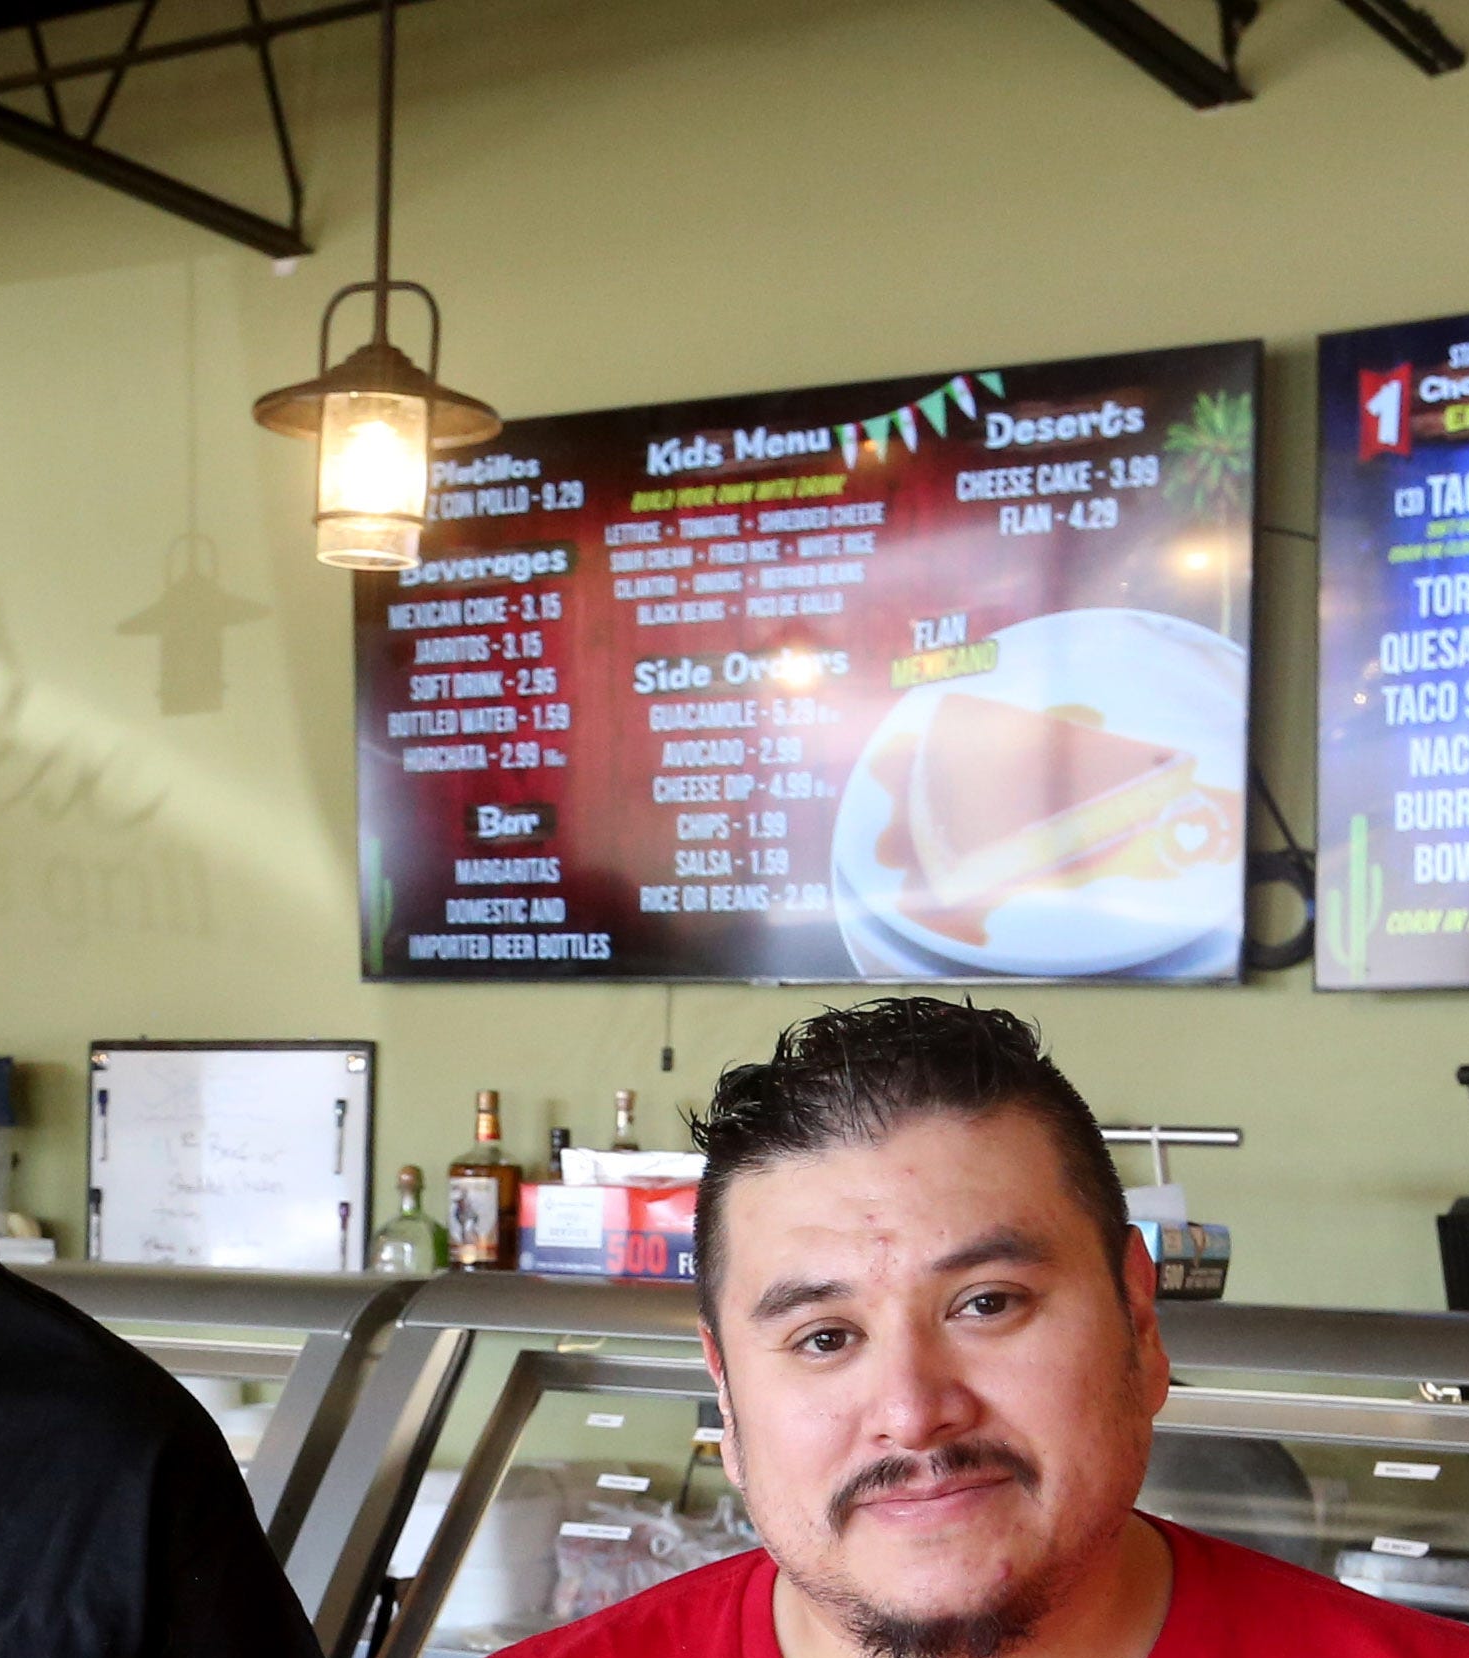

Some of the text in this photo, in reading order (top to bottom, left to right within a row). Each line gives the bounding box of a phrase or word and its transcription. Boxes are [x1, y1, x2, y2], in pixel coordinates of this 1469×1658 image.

[983, 400, 1145, 450] Deserts
[1365, 379, 1403, 446] 1
[645, 426, 831, 477] Kids Menu
[955, 454, 1160, 502] CHEESE CAKE 3.99
[999, 497, 1119, 536] FLAN 4.29
[398, 549, 568, 588] Beverages
[388, 600, 463, 630] MEXICAN
[463, 596, 509, 625] COKE
[912, 613, 967, 651] FLAN
[409, 673, 451, 702] SOFT
[633, 657, 713, 695] Side
[1381, 680, 1459, 727] TACO
[652, 774, 722, 804] CHEESE
[476, 804, 540, 839] Bar
[676, 811, 730, 840] CHIPS
[455, 856, 561, 885] MARGARITAS
[674, 849, 732, 877] SALSA
[445, 896, 566, 925] DOMESTIC AND
[639, 885, 680, 913] RICE
[709, 884, 770, 912] BEANS
[408, 932, 611, 960] IMPORTED BEER BOTTLES
[606, 1233, 668, 1275] 500
